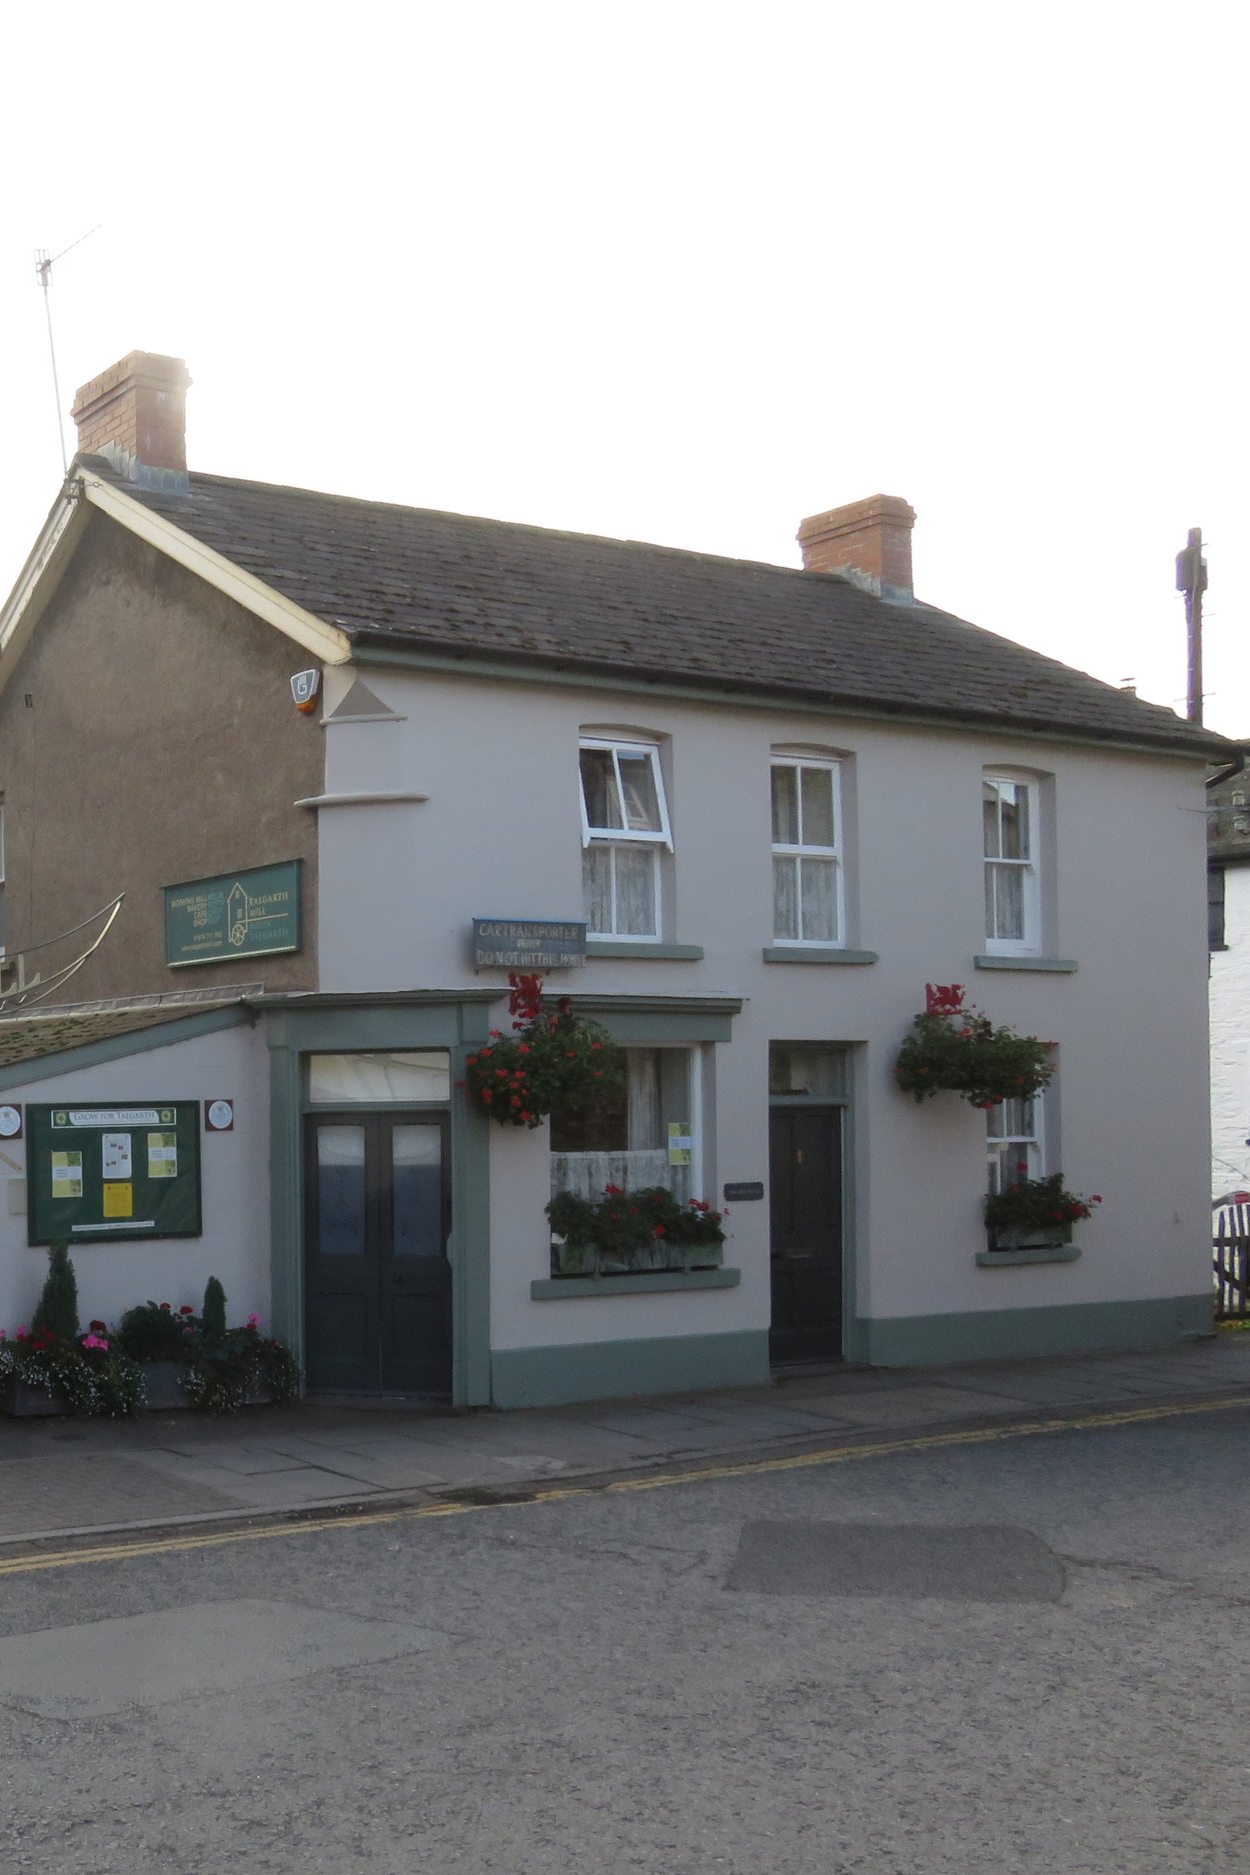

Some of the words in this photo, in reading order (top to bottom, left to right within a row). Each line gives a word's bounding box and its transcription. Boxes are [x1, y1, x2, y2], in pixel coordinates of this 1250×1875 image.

[249, 891, 288, 906] TALGARTH
[249, 908, 265, 918] MILL
[250, 928, 288, 941] TALGARTH
[479, 923, 501, 937] CAR
[503, 923, 579, 940] TRANSPORTER
[477, 950, 494, 965] DO
[495, 951, 519, 966] NOT
[117, 1110, 155, 1119] TALGARTH
